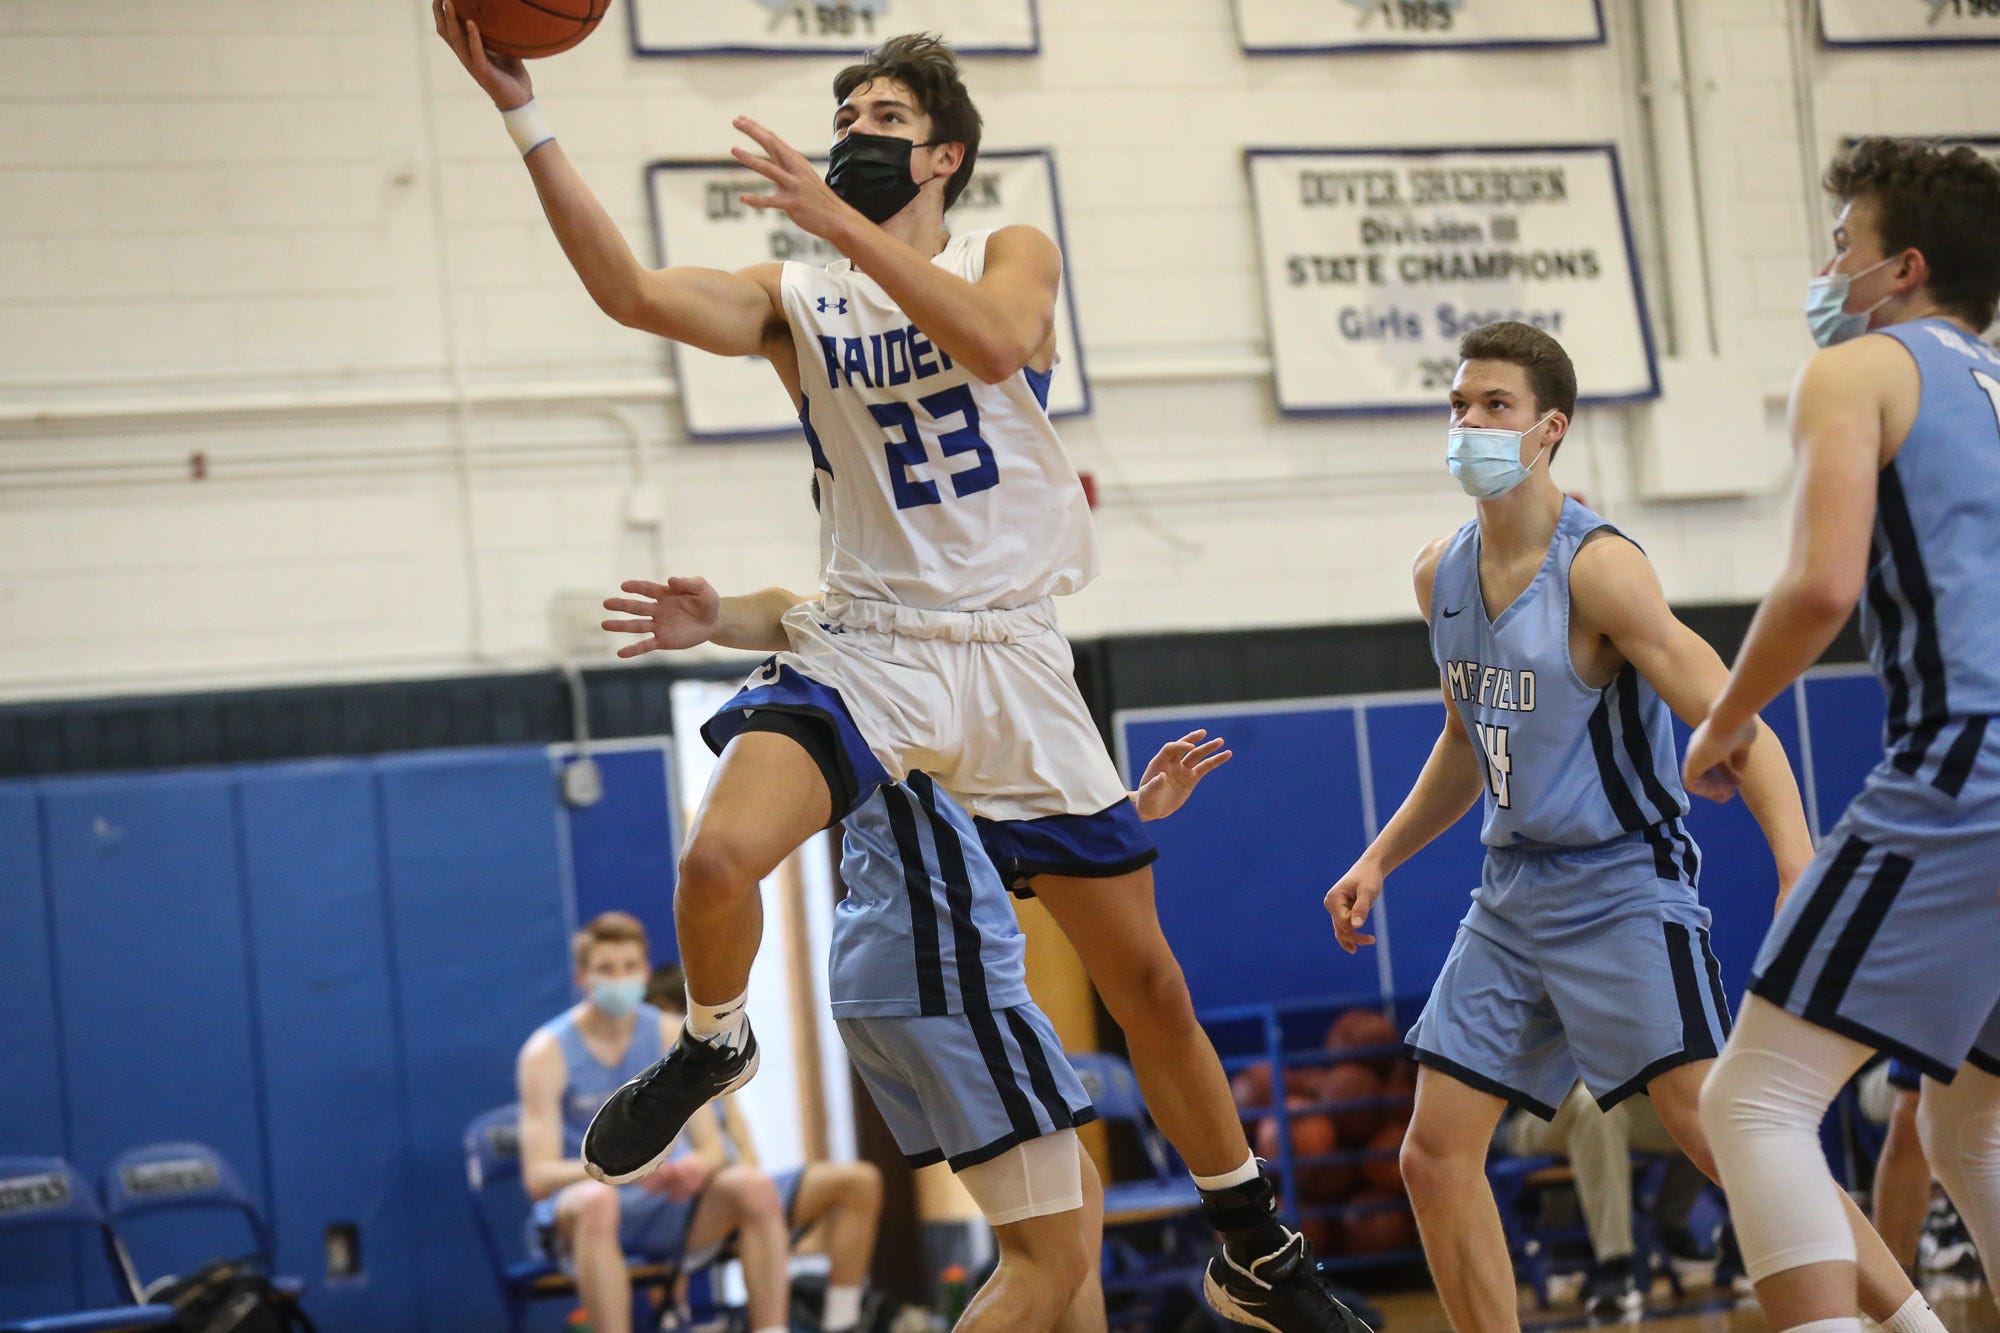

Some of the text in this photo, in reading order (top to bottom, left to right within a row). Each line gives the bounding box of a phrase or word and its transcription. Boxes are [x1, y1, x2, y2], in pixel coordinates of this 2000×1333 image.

[1360, 217, 1483, 246] Division
[1286, 248, 1601, 286] STATE CHAMPIONS
[1338, 304, 1422, 341] Girls
[867, 383, 1000, 510] 23
[1446, 660, 1536, 712] MEFIELD
